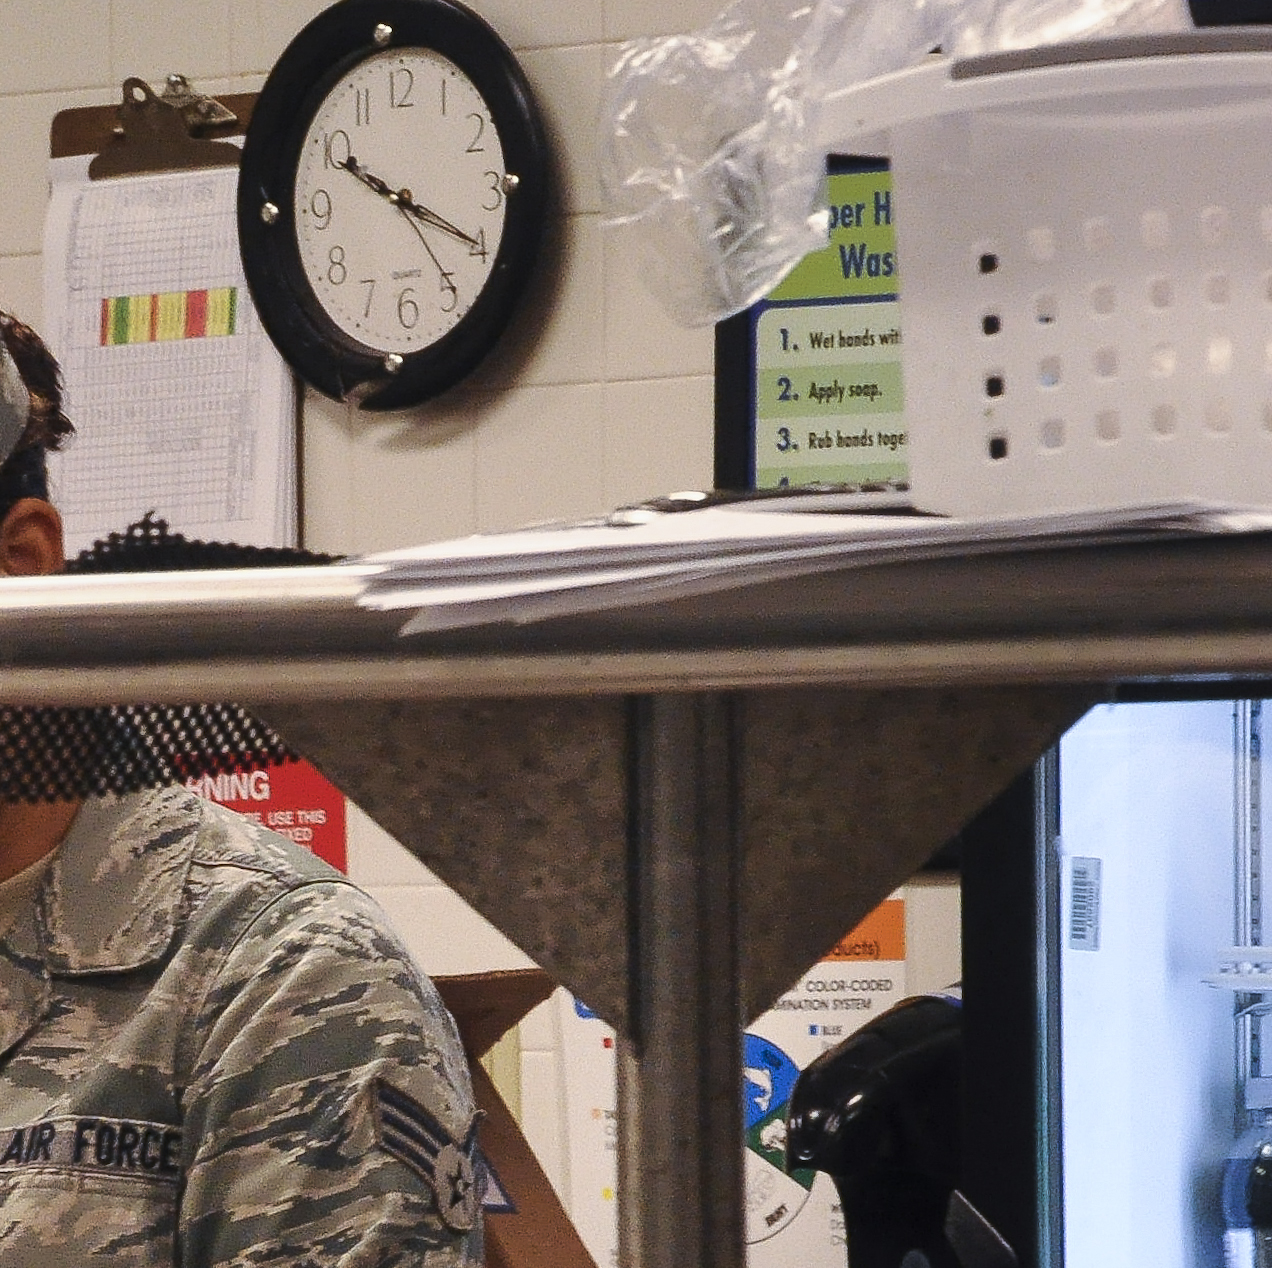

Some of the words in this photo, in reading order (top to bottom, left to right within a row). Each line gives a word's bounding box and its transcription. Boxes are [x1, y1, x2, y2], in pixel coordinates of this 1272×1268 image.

[356, 88, 370, 126] 11
[389, 68, 414, 108] 12
[440, 79, 448, 116] 1
[324, 130, 351, 170] 10
[466, 113, 485, 153] 2
[311, 189, 332, 231] 9
[481, 170, 503, 211] 3
[468, 226, 490, 264] 4
[328, 245, 347, 286] 8
[360, 278, 376, 319] 7
[398, 287, 419, 329] 6
[439, 271, 458, 313] 5
[780, 328, 800, 351] 1.
[809, 331, 834, 349] Wet
[839, 329, 875, 348] hands
[777, 376, 799, 401] 2.
[808, 379, 844, 404] Apply
[849, 382, 883, 402] soap.
[776, 427, 800, 452] 3.
[808, 430, 832, 450] Rub
[836, 428, 873, 448] hands
[267, 811, 295, 826] USE
[297, 809, 327, 825] THIS
[807, 978, 893, 993] COLOR-CODED
[832, 998, 873, 1011] SYSTEM
[0, 1122, 56, 1166] AIR
[73, 1117, 184, 1174] FORCE
